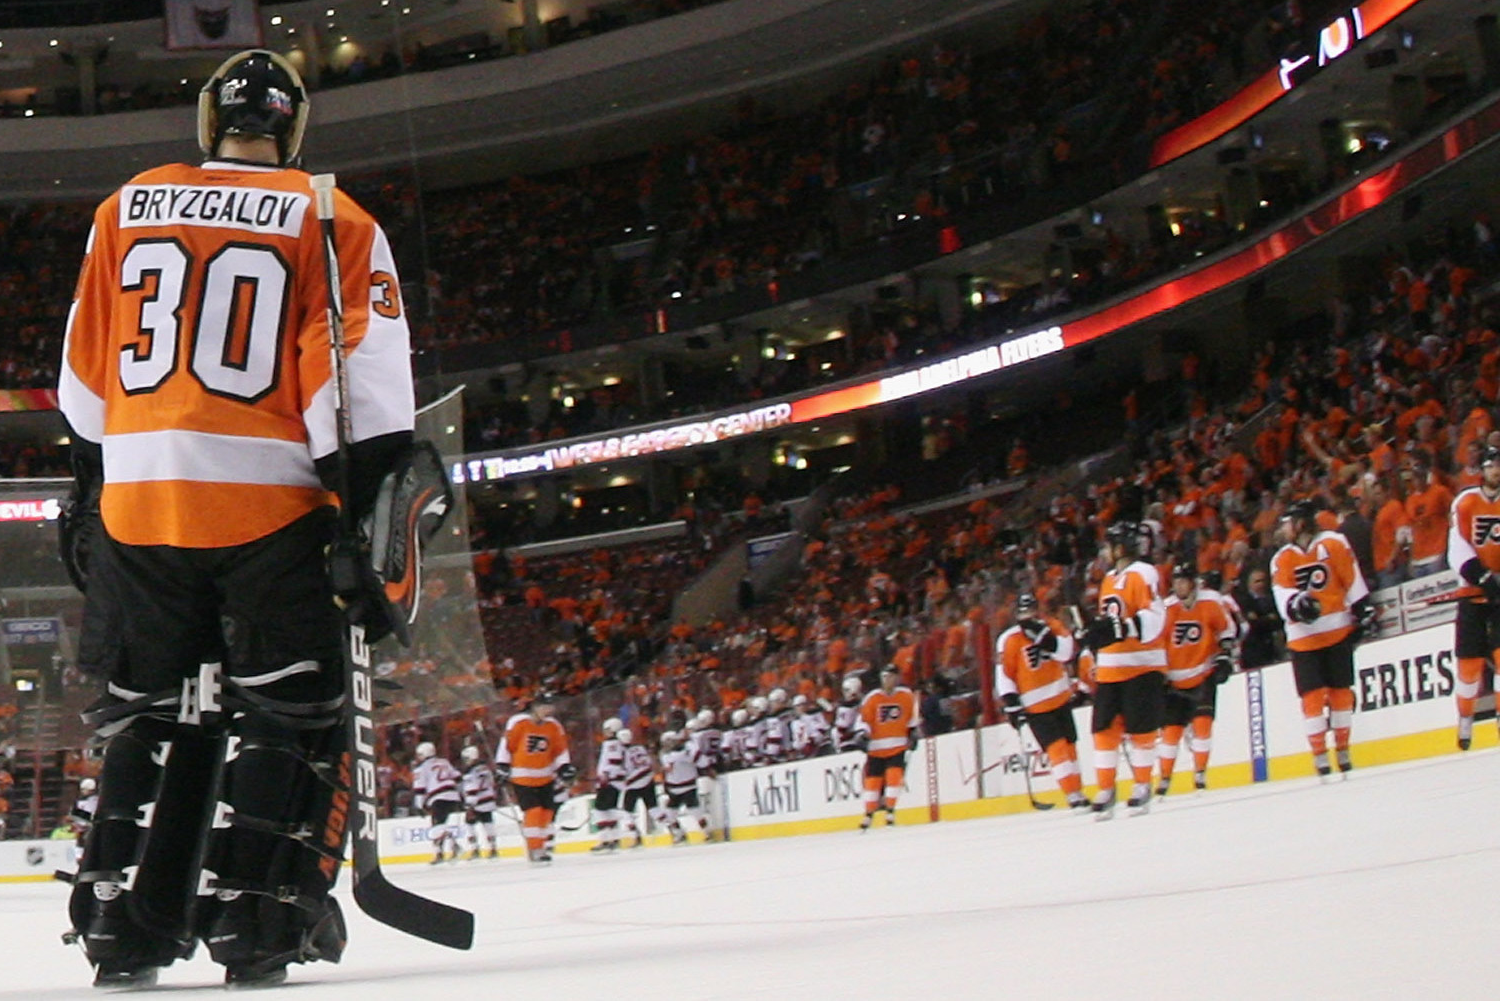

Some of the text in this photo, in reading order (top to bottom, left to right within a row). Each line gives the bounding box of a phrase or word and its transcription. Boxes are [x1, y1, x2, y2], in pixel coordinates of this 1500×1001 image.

[127, 189, 300, 229] BRYZGALOV
[119, 236, 291, 405] 30
[1356, 649, 1454, 713] ERIES
[749, 769, 800, 817] Advil
